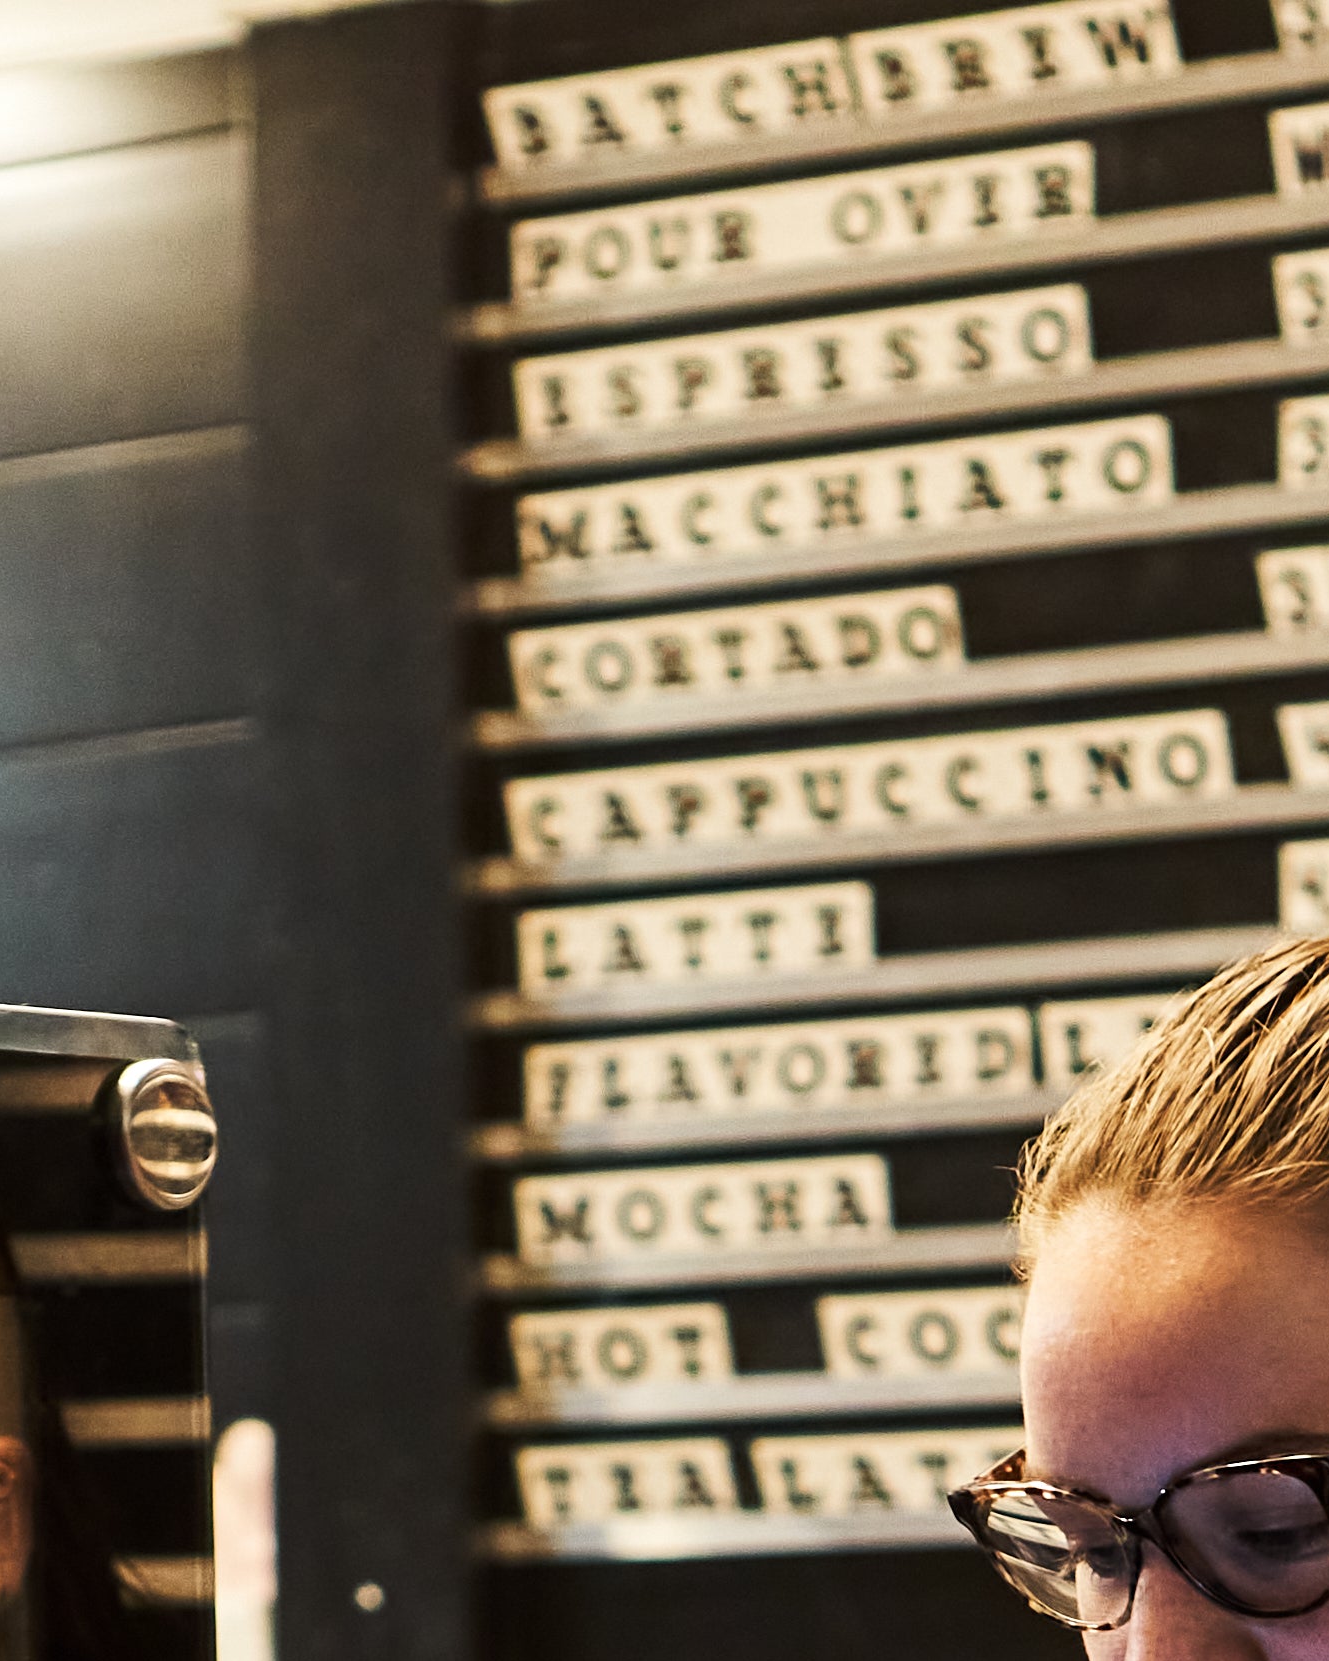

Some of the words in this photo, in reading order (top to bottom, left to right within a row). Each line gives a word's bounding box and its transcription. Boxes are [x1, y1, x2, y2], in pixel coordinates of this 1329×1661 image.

[511, 58, 837, 156] BATCH
[874, 14, 1157, 103] BREW
[531, 210, 754, 290] POUR
[831, 164, 1074, 246] OVER
[540, 308, 1073, 428] ESPRESSO
[521, 437, 1154, 562] MACCHIATO
[529, 604, 947, 698] CORTADO
[527, 730, 1209, 850] CAPPUCCINO
[540, 902, 849, 978] LATTE
[546, 1027, 1018, 1112] FLAVORED
[540, 1177, 870, 1242] MOCHA
[520, 1324, 707, 1389] HOT
[846, 1305, 1020, 1368] COC
[543, 1458, 725, 1521] TEA
[779, 1452, 961, 1516] LAT
